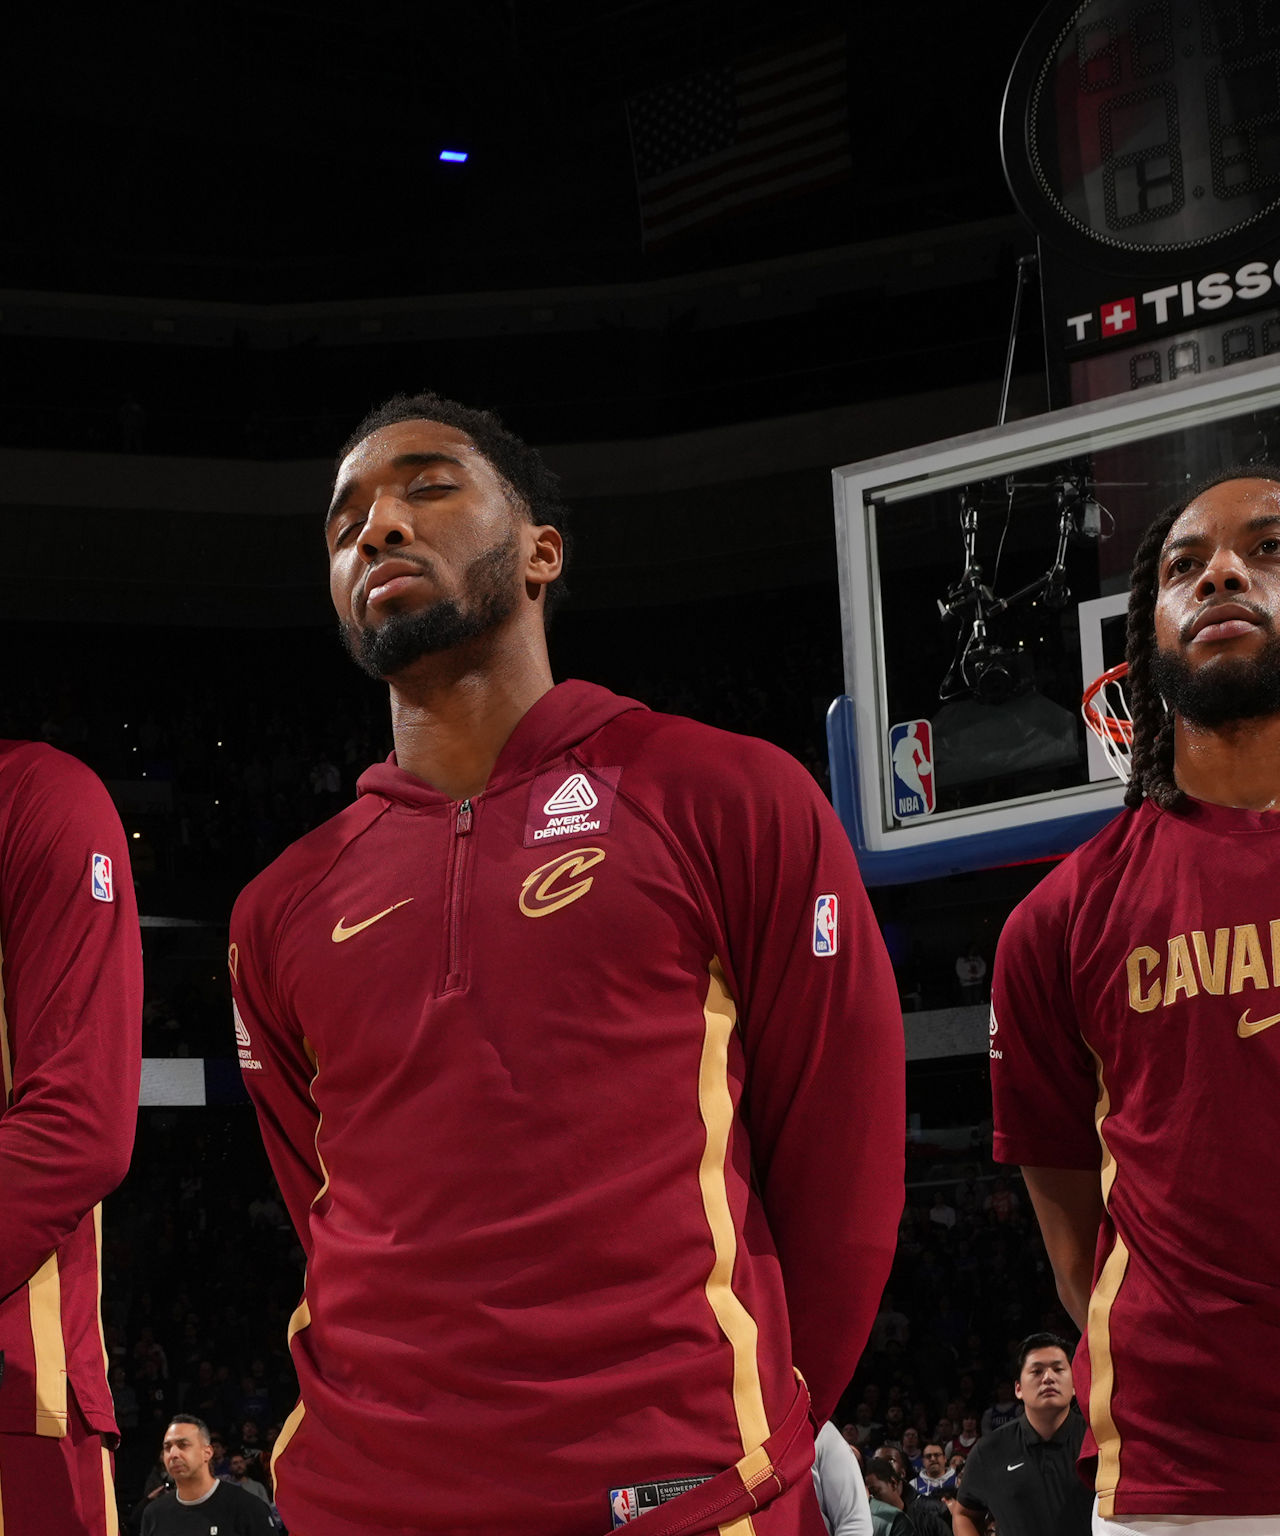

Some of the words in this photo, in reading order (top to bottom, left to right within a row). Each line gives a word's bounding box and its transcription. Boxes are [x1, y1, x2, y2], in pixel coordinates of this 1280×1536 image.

[1067, 312, 1093, 341] T
[898, 796, 920, 814] NBA
[533, 820, 600, 840] DENNISON
[546, 813, 591, 828] AVERY
[519, 847, 606, 918] C
[644, 1492, 652, 1502] L
